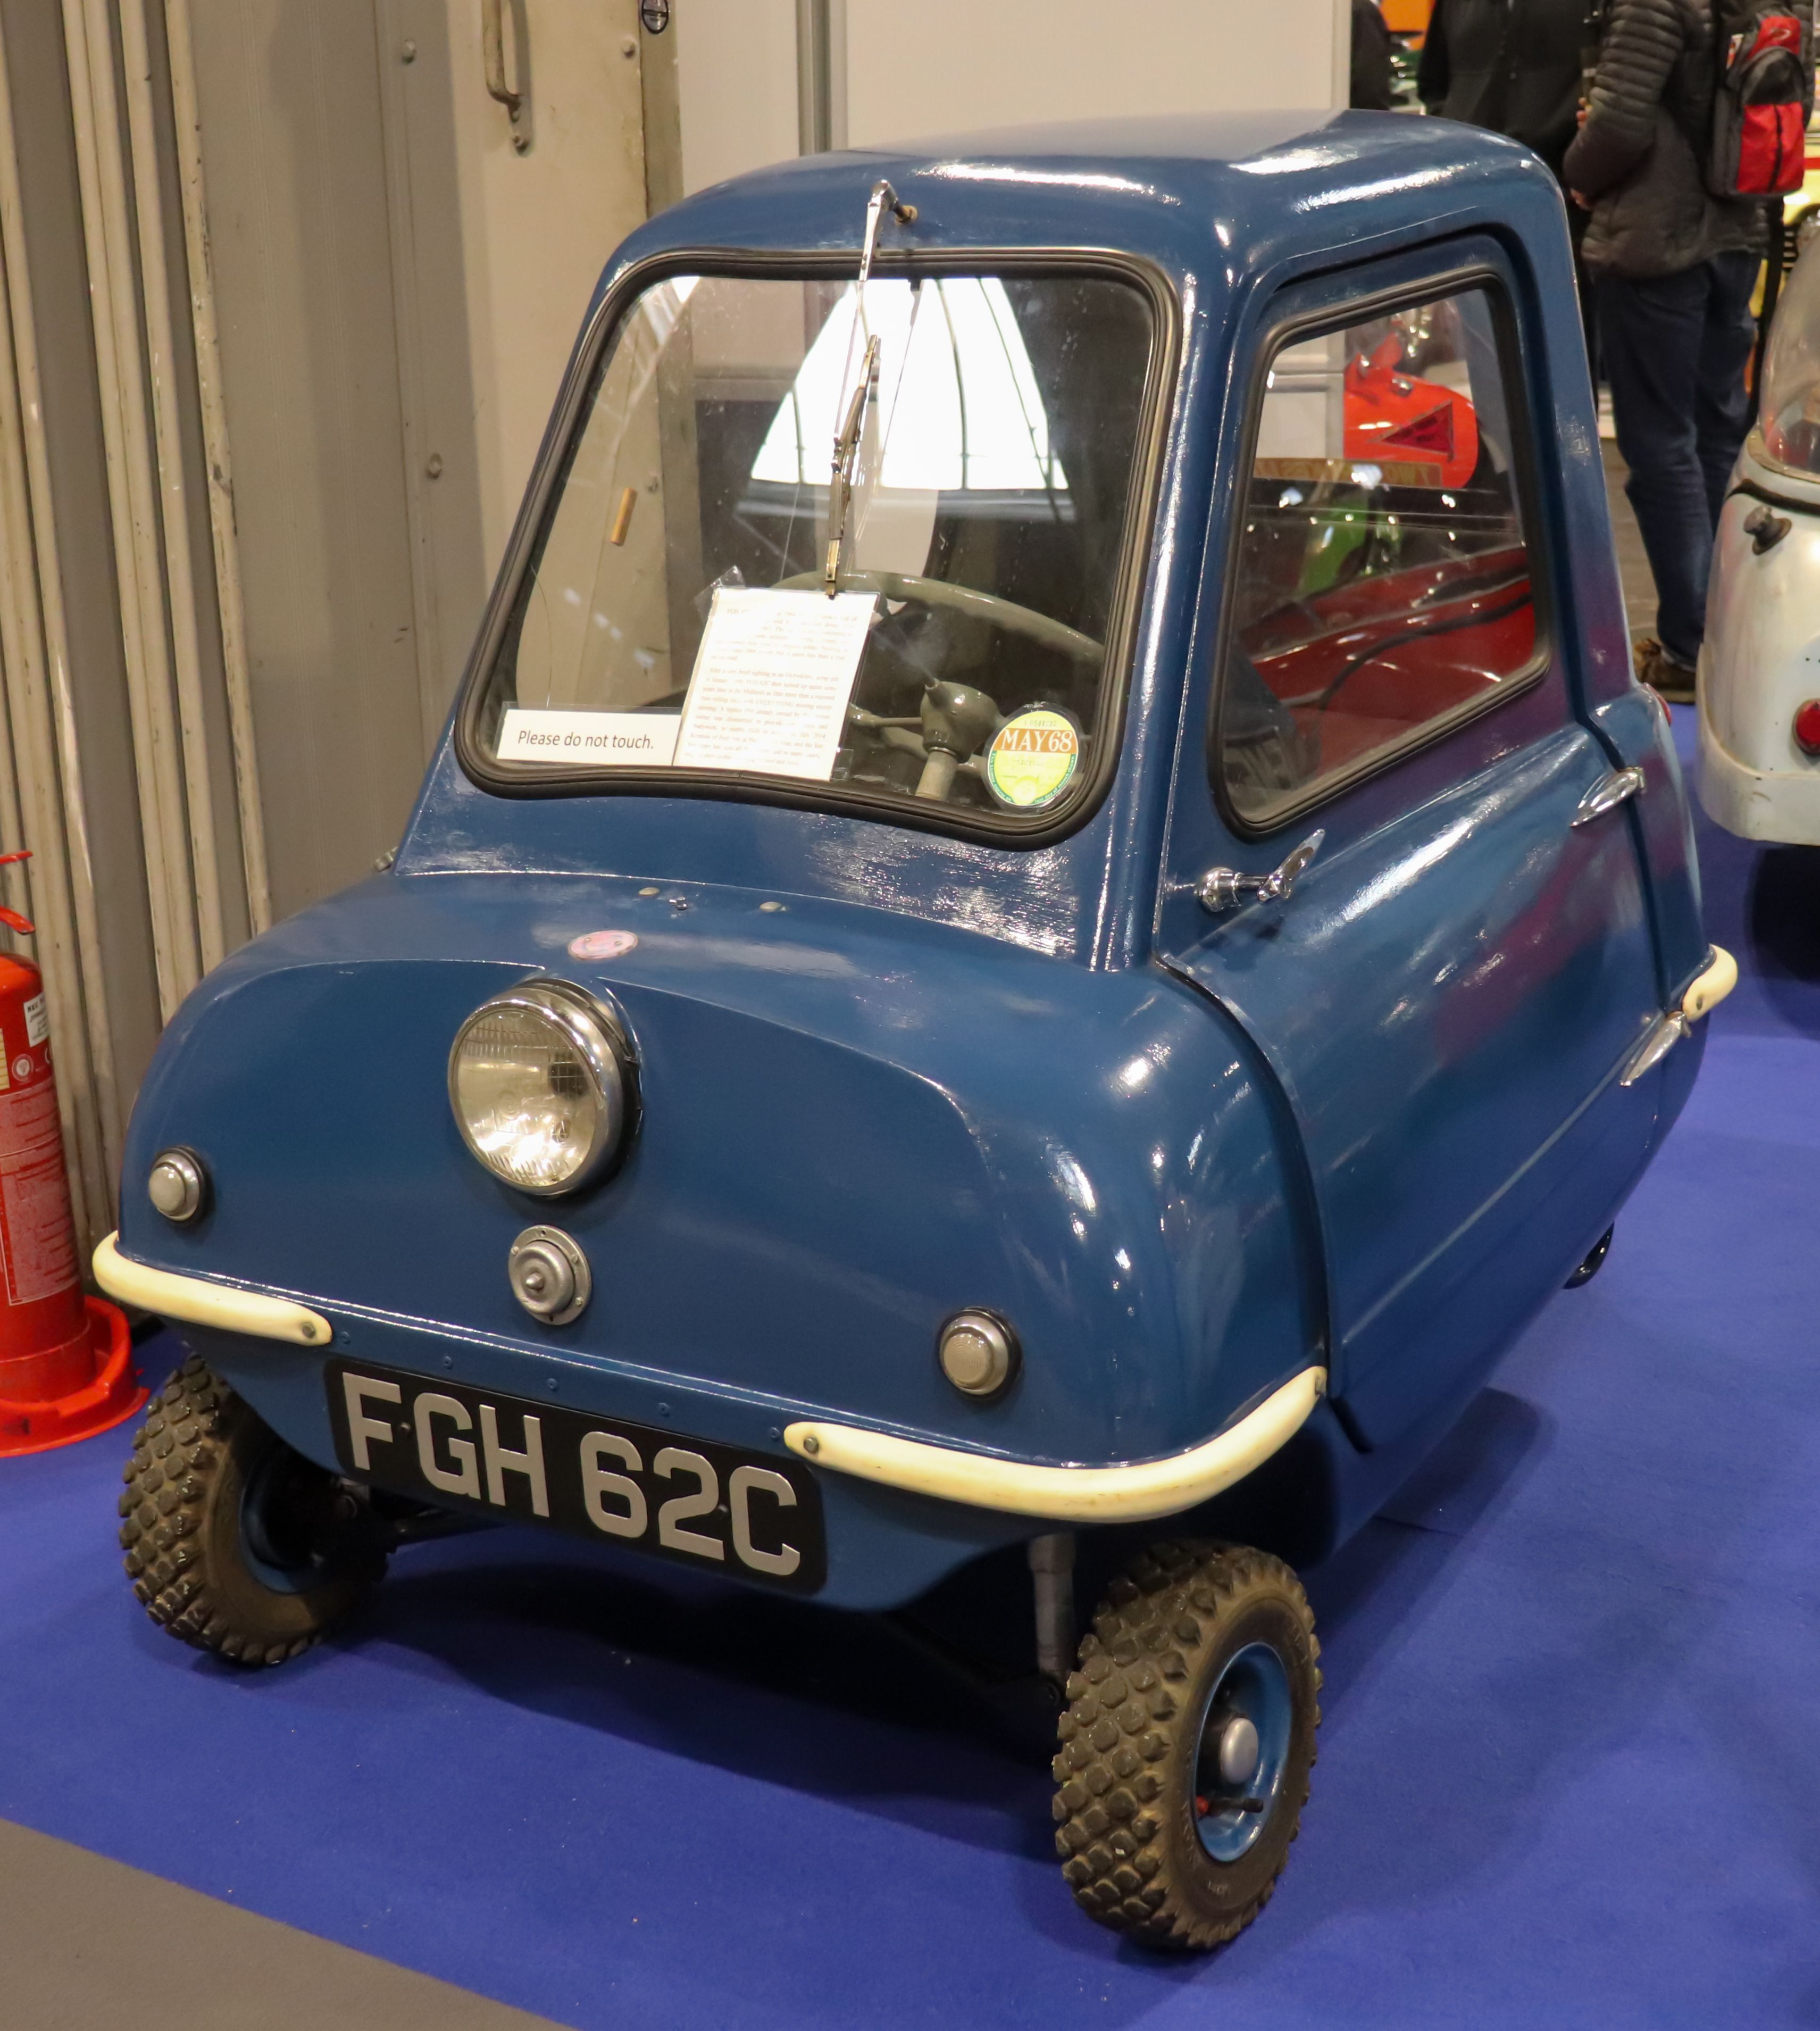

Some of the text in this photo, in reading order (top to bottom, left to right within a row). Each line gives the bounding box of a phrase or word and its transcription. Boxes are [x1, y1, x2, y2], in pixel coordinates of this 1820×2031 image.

[518, 730, 654, 749] Please do not touch.
[342, 1371, 801, 1576] FGH 62C
